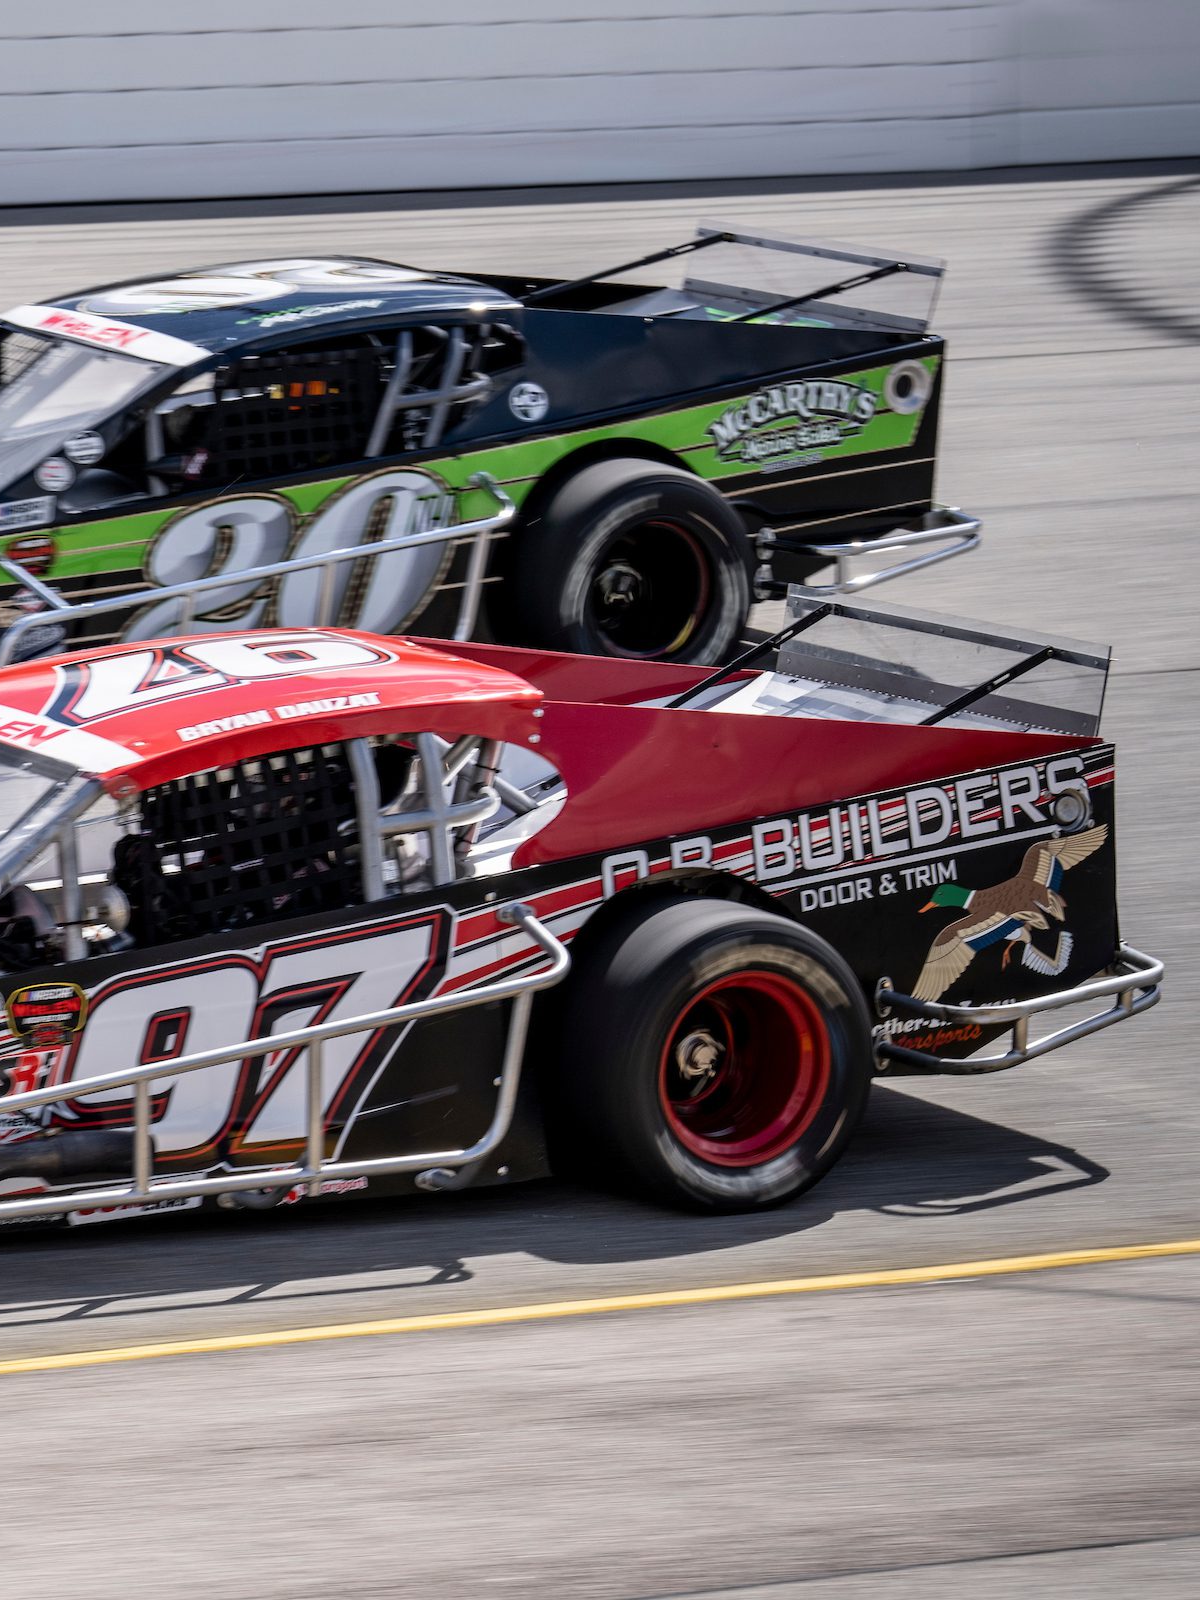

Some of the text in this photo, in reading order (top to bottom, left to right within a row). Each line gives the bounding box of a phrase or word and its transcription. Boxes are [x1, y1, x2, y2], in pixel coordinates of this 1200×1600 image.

[119, 465, 459, 635] 20
[176, 692, 382, 742] BRYAN DAUZAT
[751, 756, 1085, 882] BUILDERS
[801, 859, 958, 912] DOOR & TRIM
[65, 903, 456, 1168] 97
